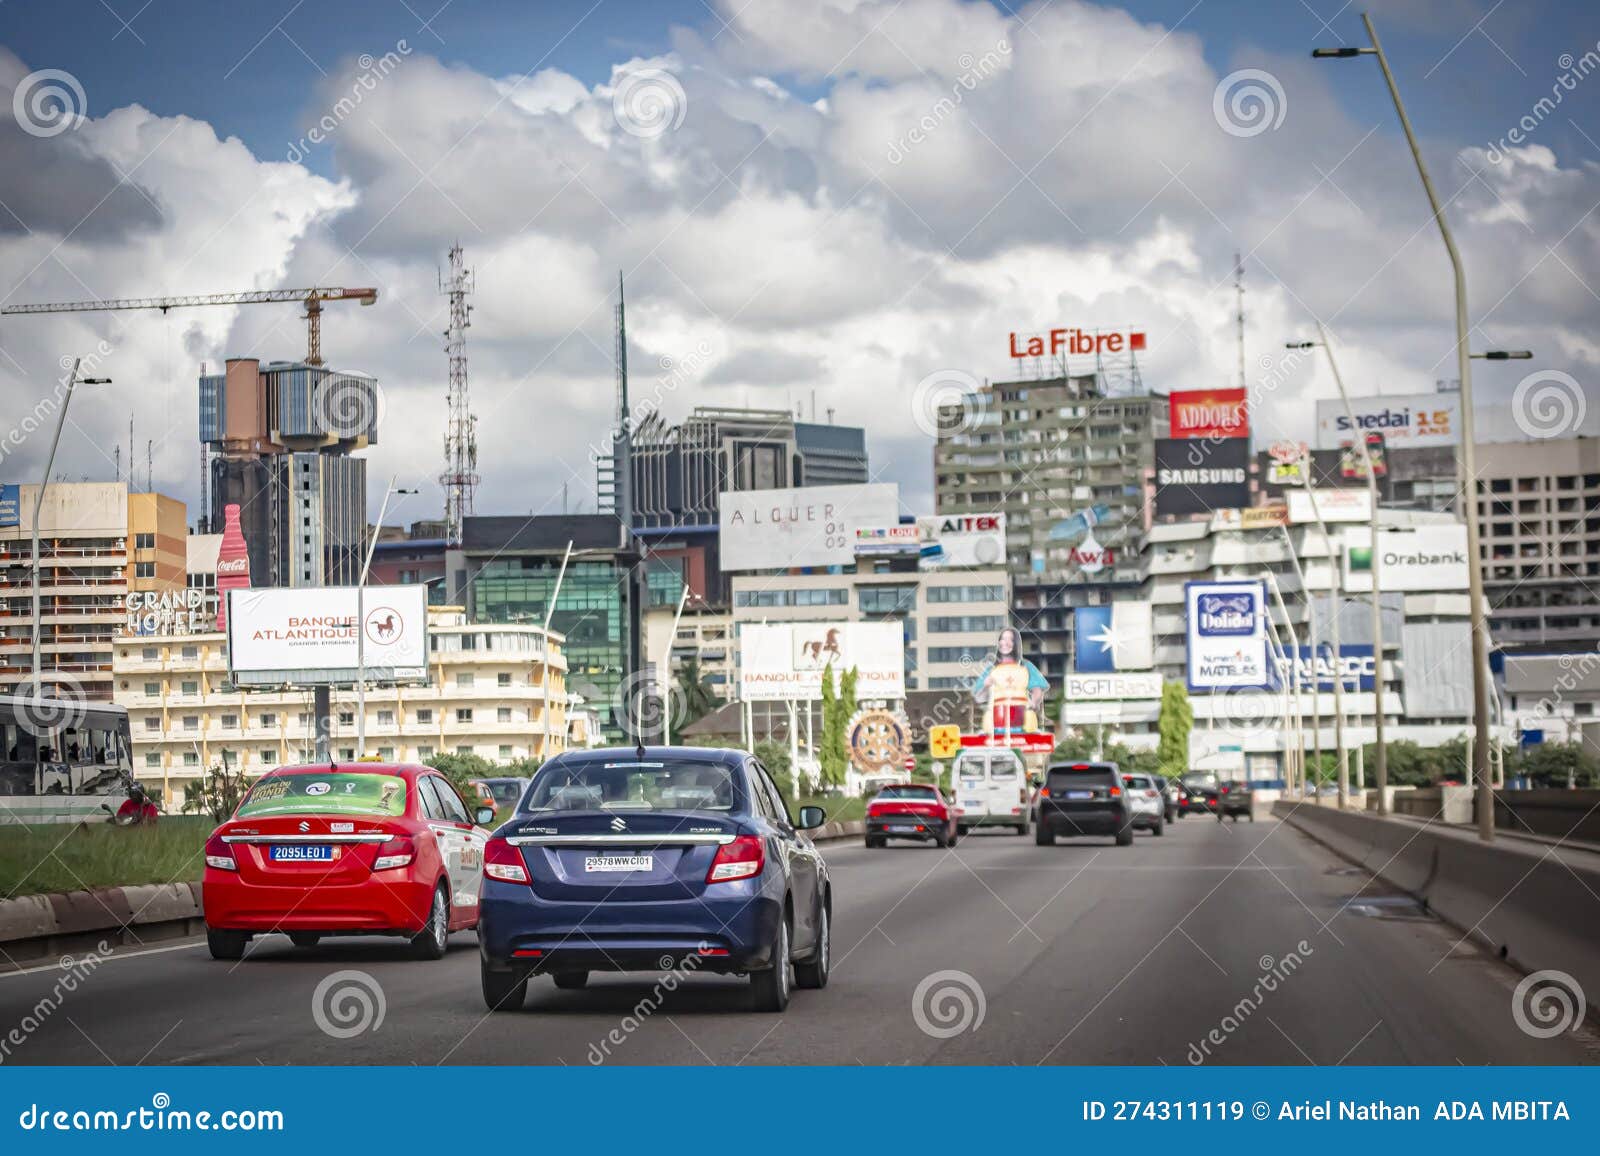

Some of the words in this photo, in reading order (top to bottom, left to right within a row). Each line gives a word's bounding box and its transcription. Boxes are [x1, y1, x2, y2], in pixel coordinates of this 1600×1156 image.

[1009, 332, 1044, 358] La
[1050, 328, 1123, 354] Fibre
[1159, 467, 1246, 485] SAMSUNG
[941, 516, 1000, 533] AITEK
[1068, 547, 1115, 567] Awa
[1383, 551, 1467, 566] Orabank
[125, 588, 203, 611] GRAND
[127, 609, 208, 632] HOTEL
[288, 616, 358, 628] BANQUE
[1201, 612, 1254, 629] Dolidol
[252, 628, 359, 641] ATLANTIQUE
[275, 847, 326, 859] 2095LE01
[587, 857, 650, 866] 29578WWCI01
